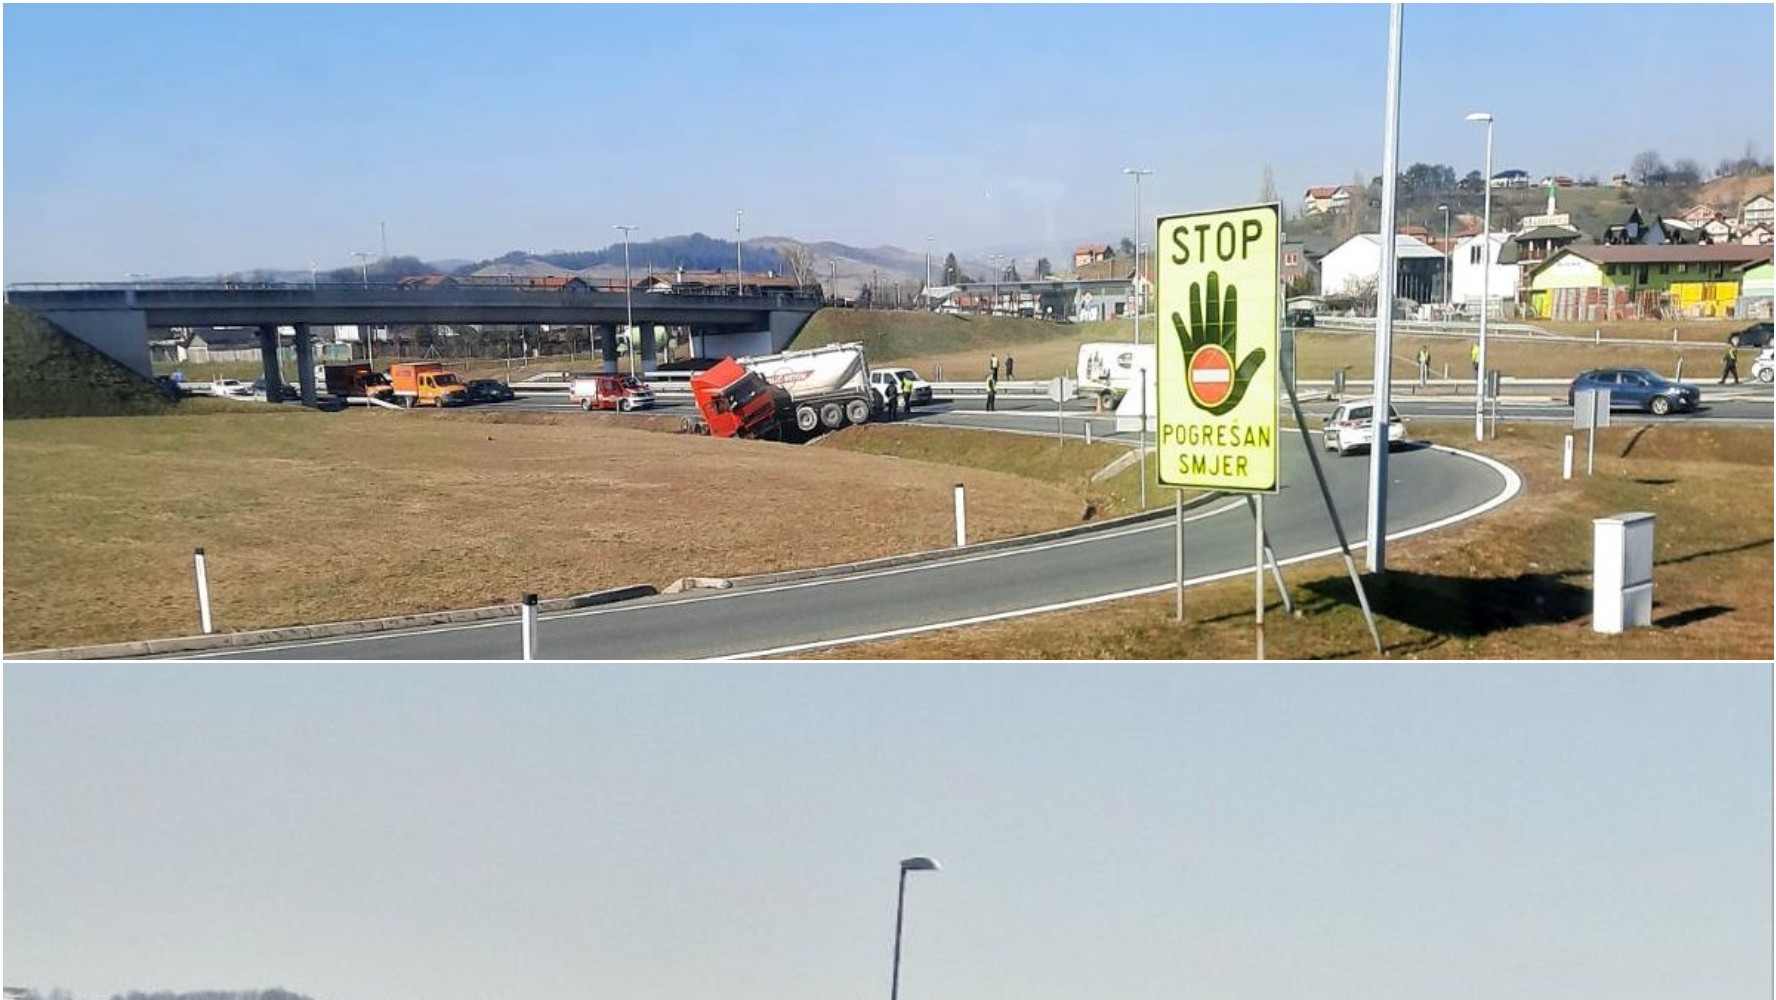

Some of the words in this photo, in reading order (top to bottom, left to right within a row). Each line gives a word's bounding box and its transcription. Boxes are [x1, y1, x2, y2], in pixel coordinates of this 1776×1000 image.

[1172, 219, 1262, 265] STOP
[1163, 418, 1270, 447] POGREŠAN
[1179, 454, 1248, 476] SMJER
